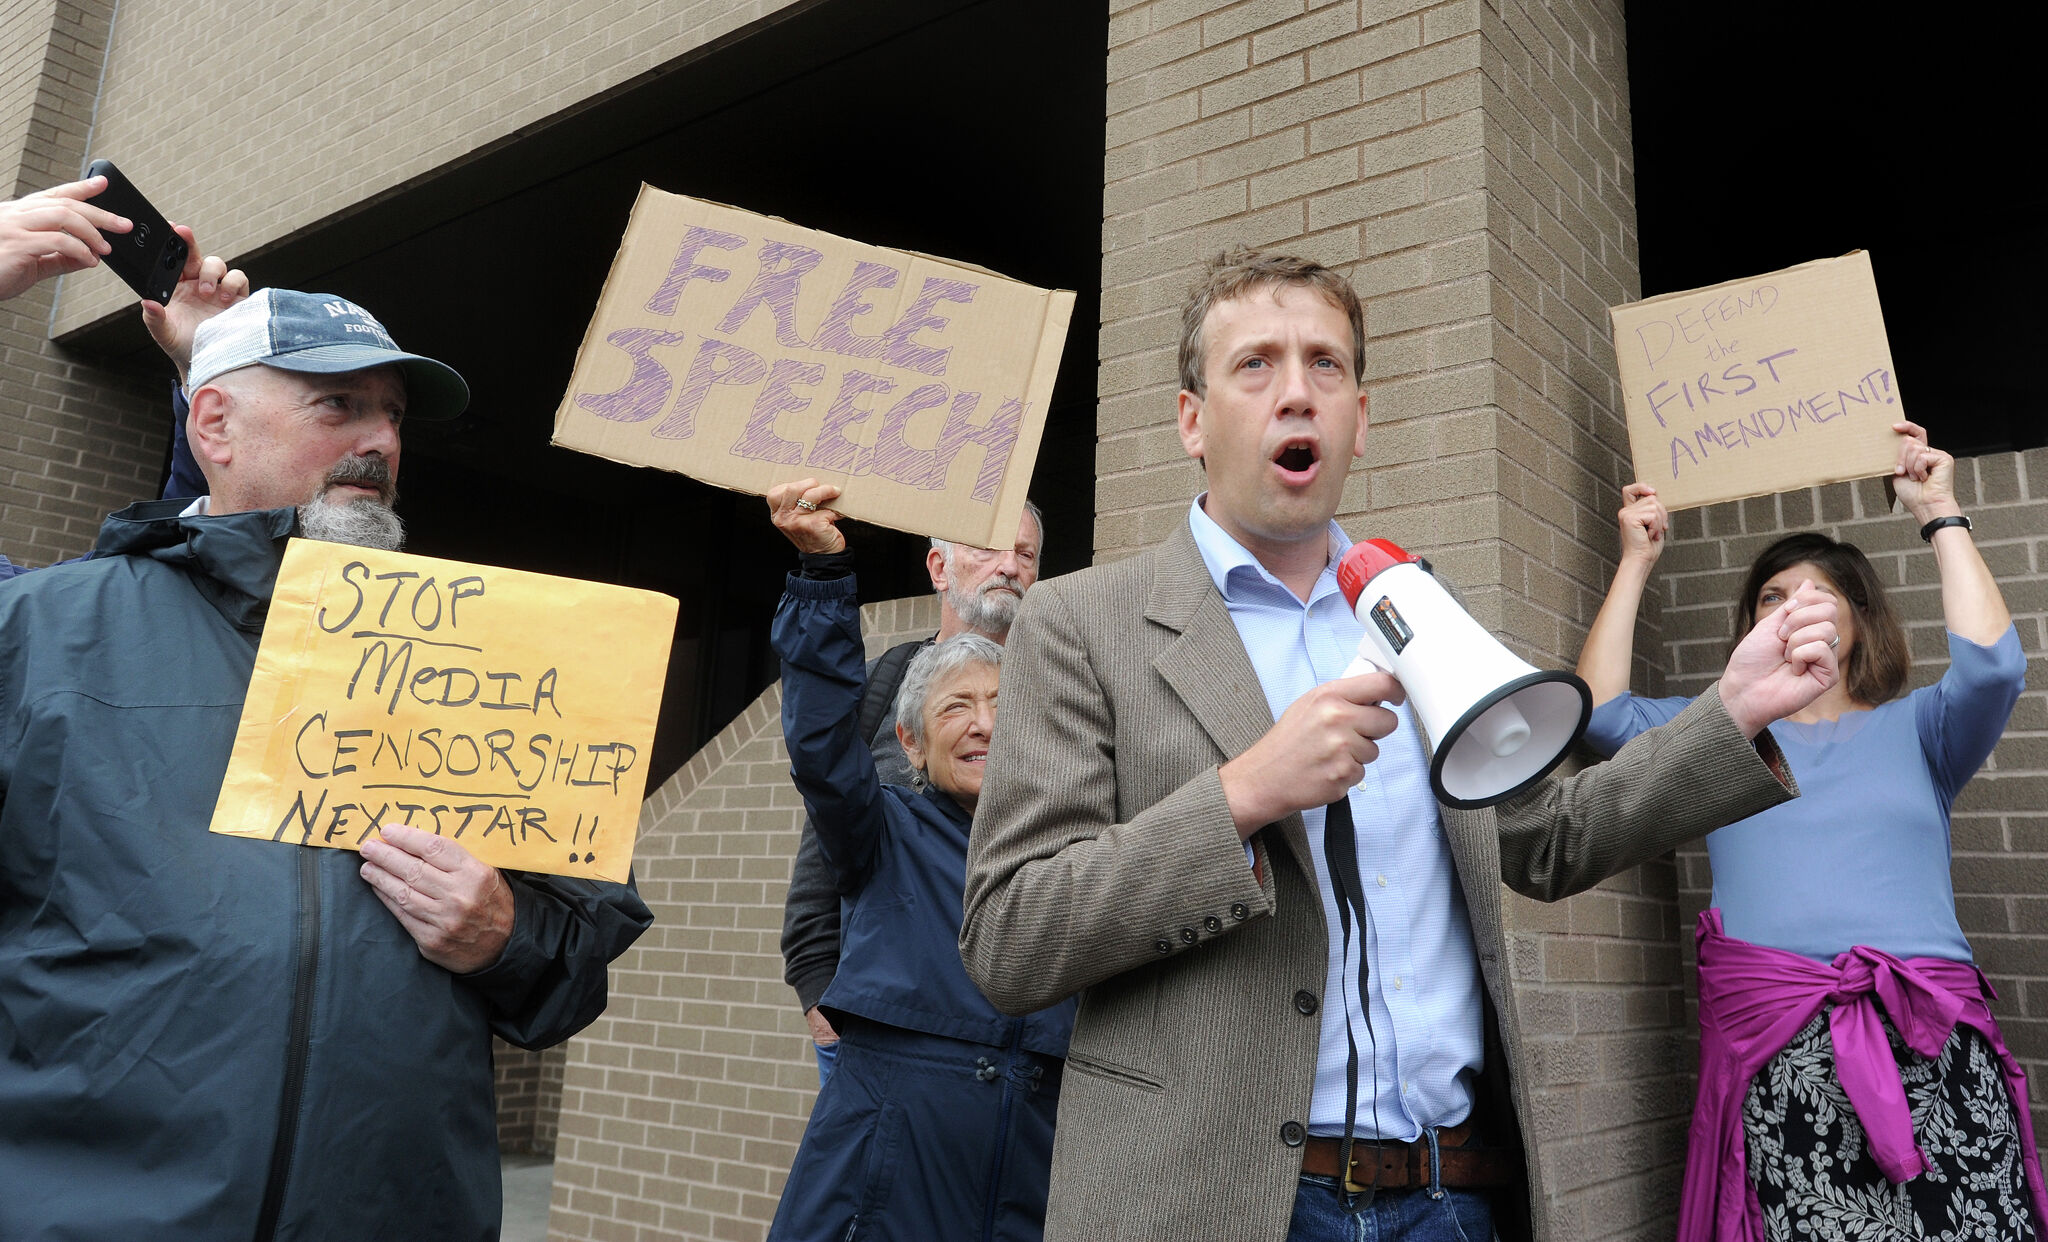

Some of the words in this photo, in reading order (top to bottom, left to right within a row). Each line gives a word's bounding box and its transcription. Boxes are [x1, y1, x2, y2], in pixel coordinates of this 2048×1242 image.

[323, 301, 376, 320] NA
[644, 224, 981, 377] FREE
[1635, 285, 1779, 371] DEFEND
[1646, 348, 1798, 428] FIRST
[1705, 337, 1742, 362] the
[574, 327, 1032, 505] SPEECH
[1670, 368, 1894, 480] AMENDMENT!
[318, 562, 485, 633] STOP
[295, 711, 637, 796] CENSORSHIP
